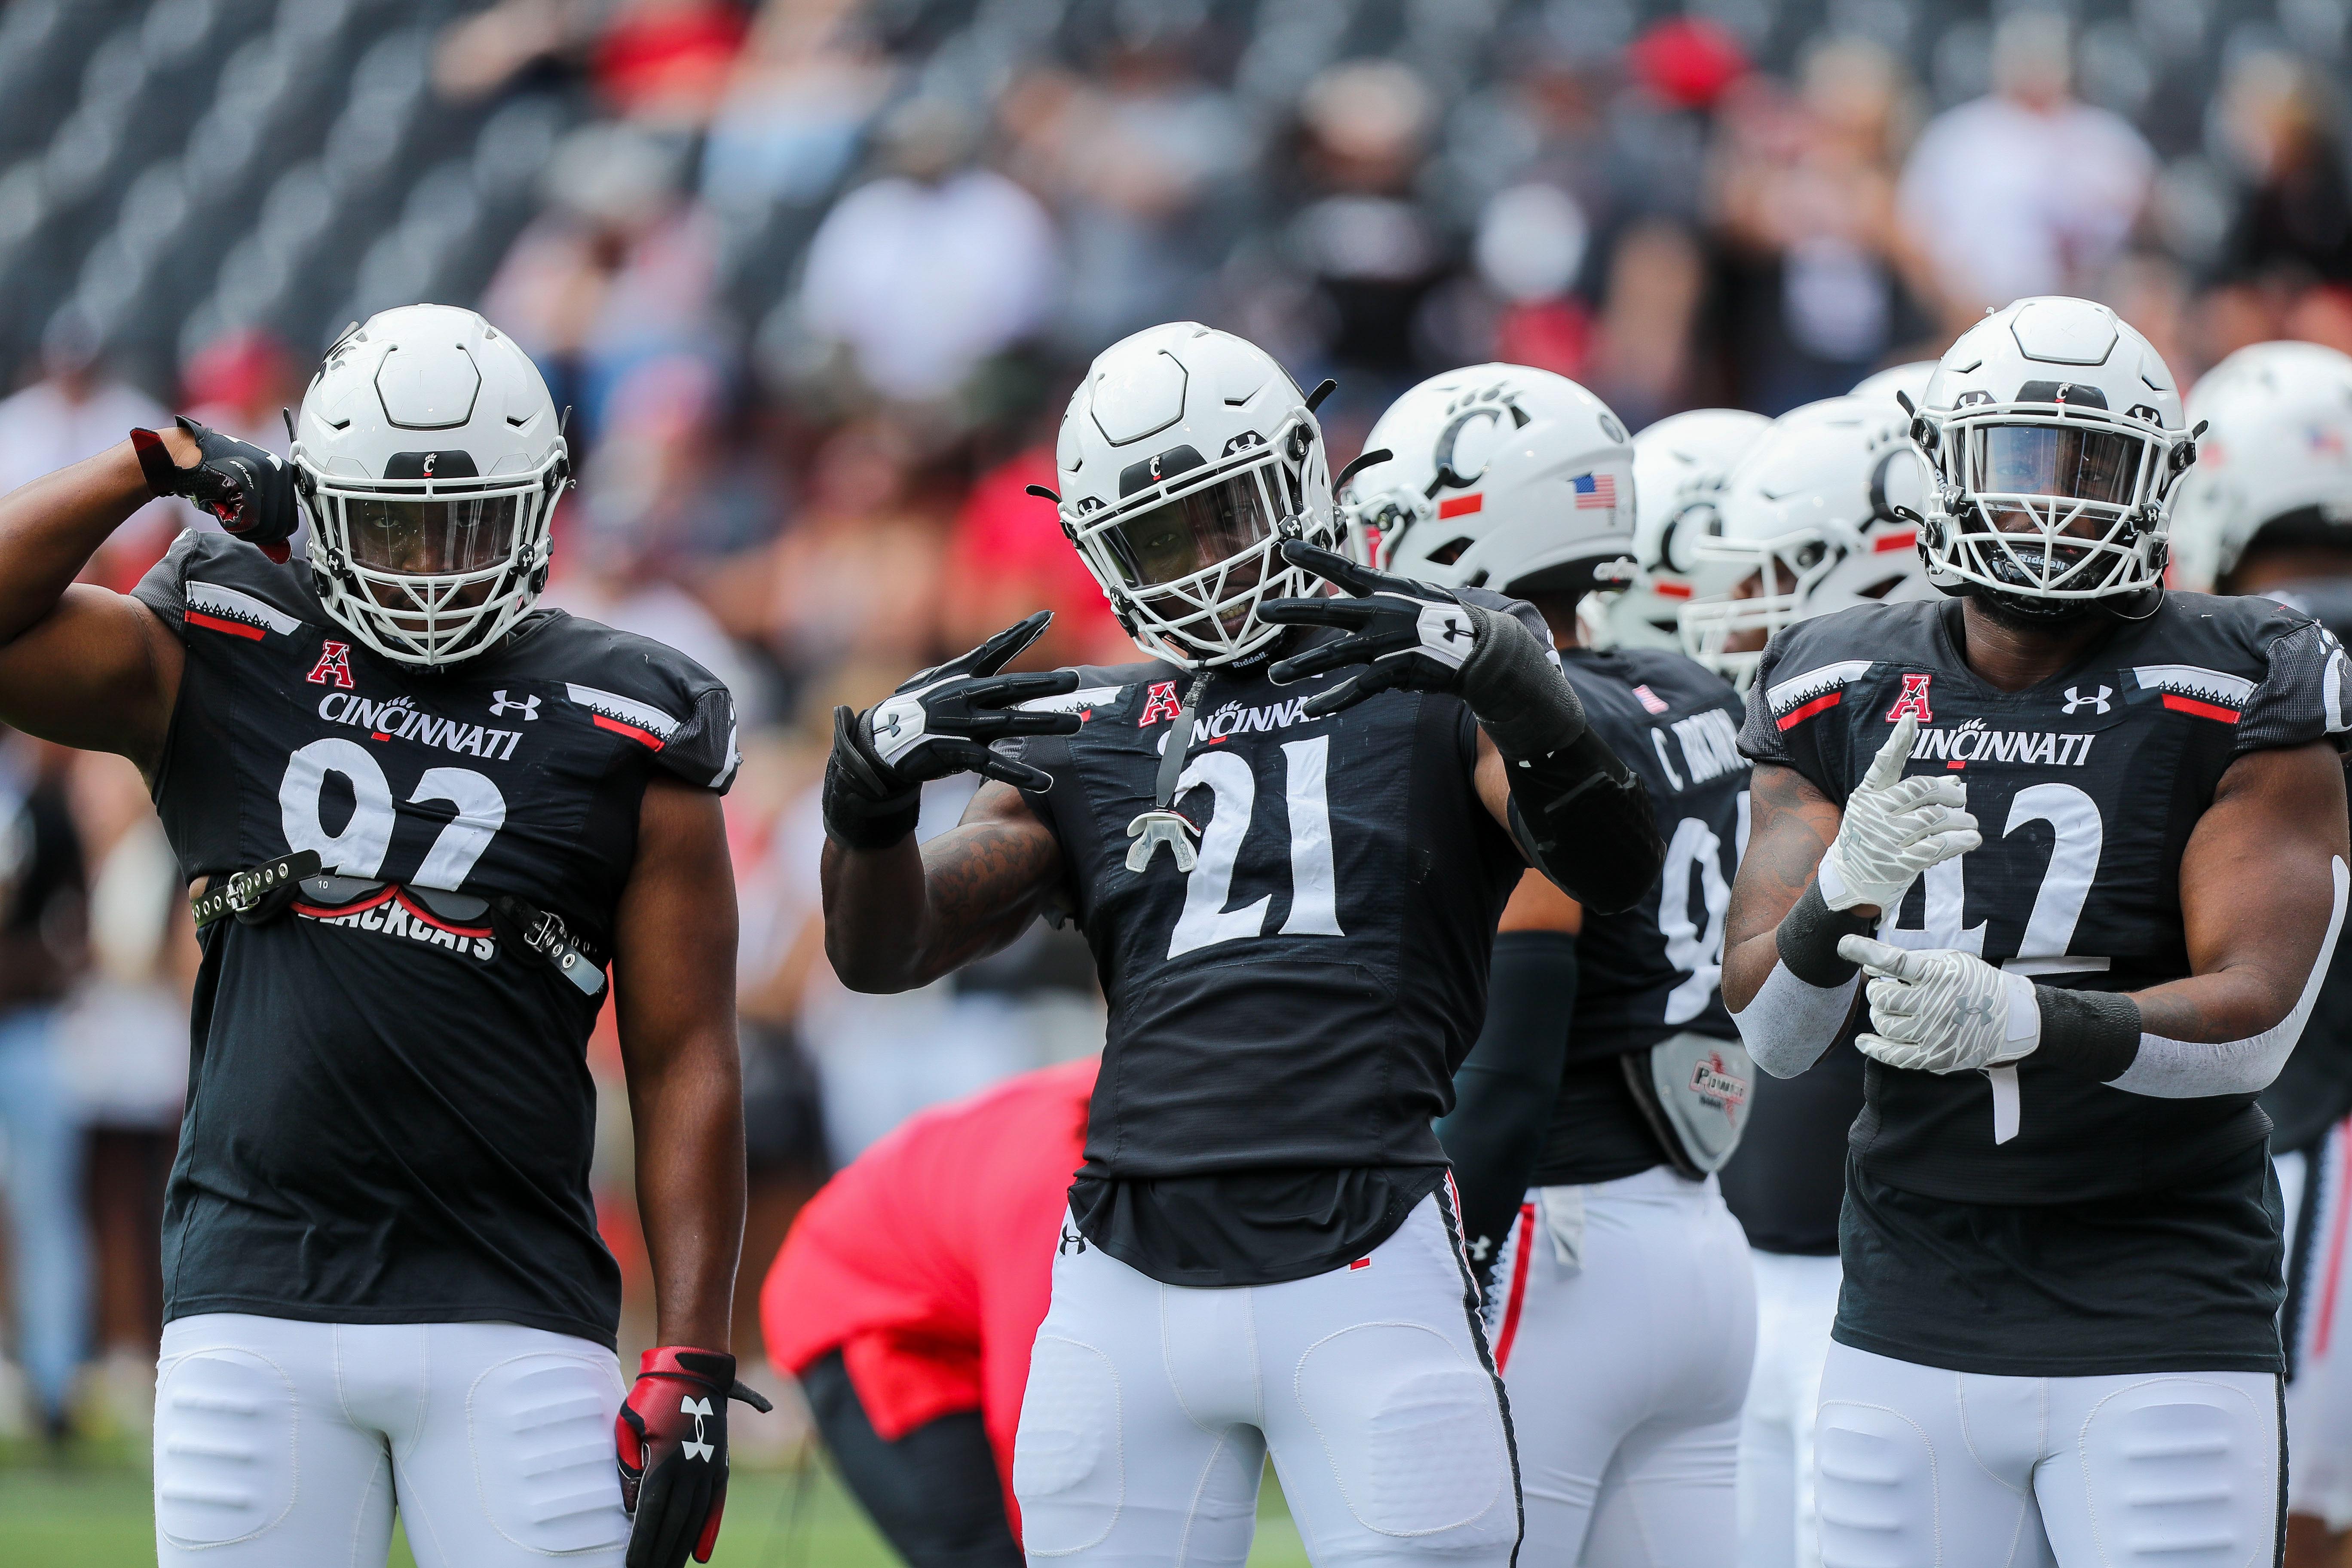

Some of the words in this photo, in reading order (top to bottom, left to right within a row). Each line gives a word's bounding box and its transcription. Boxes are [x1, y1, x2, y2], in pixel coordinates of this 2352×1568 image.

[1232, 651, 1266, 668] Riddell
[318, 692, 523, 761] CINCINNATI
[1157, 696, 1337, 756] NCINNA
[1907, 728, 2096, 766] INCINNATI
[1167, 734, 1345, 961] 21
[318, 880, 328, 889] 10
